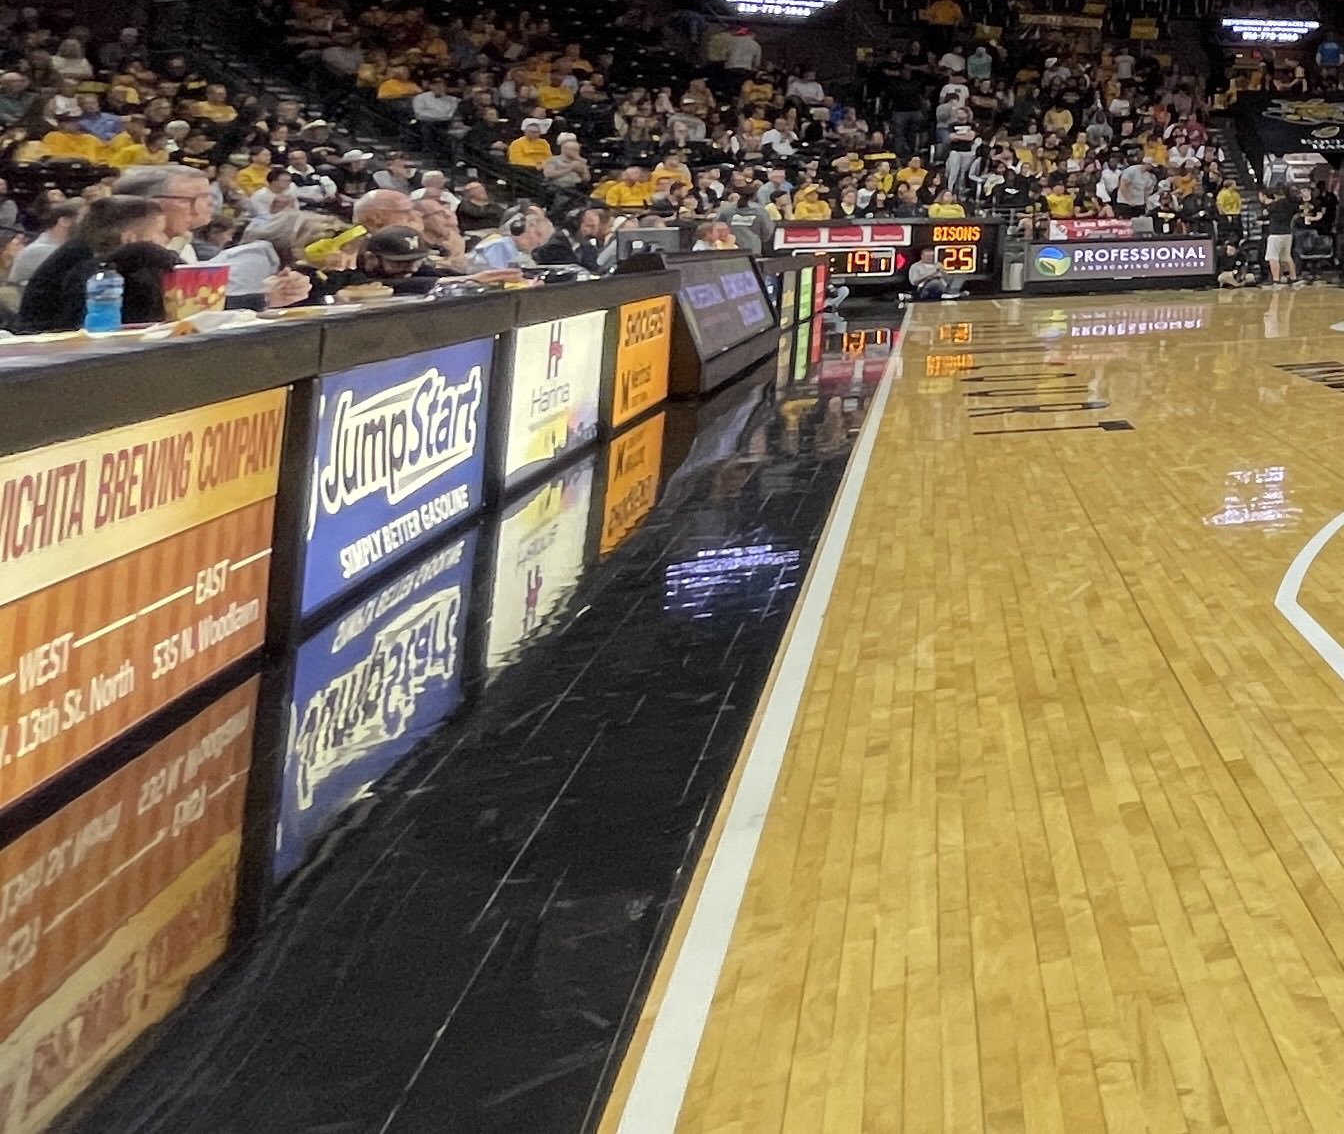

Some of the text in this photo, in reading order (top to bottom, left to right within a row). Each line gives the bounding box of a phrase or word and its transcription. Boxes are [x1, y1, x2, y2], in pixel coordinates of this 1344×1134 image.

[932, 225, 981, 243] BISONS
[943, 248, 974, 271] 25
[1073, 246, 1206, 263] PROFESSIONAL
[1073, 260, 1206, 272] LANDSCAPING SERVICES
[530, 382, 570, 418] Hanna
[322, 368, 481, 514] JumpStart
[0, 407, 284, 563] ICHITA BREWING COMPANY
[339, 484, 469, 579] SIMPLY BETTER GASOLINE
[193, 558, 231, 606] EAST
[17, 632, 74, 696] WEST
[151, 638, 180, 680] 535
[197, 597, 260, 651] Woodlawn
[16, 702, 60, 759] 13th
[61, 685, 86, 731] St.
[89, 659, 135, 714] North
